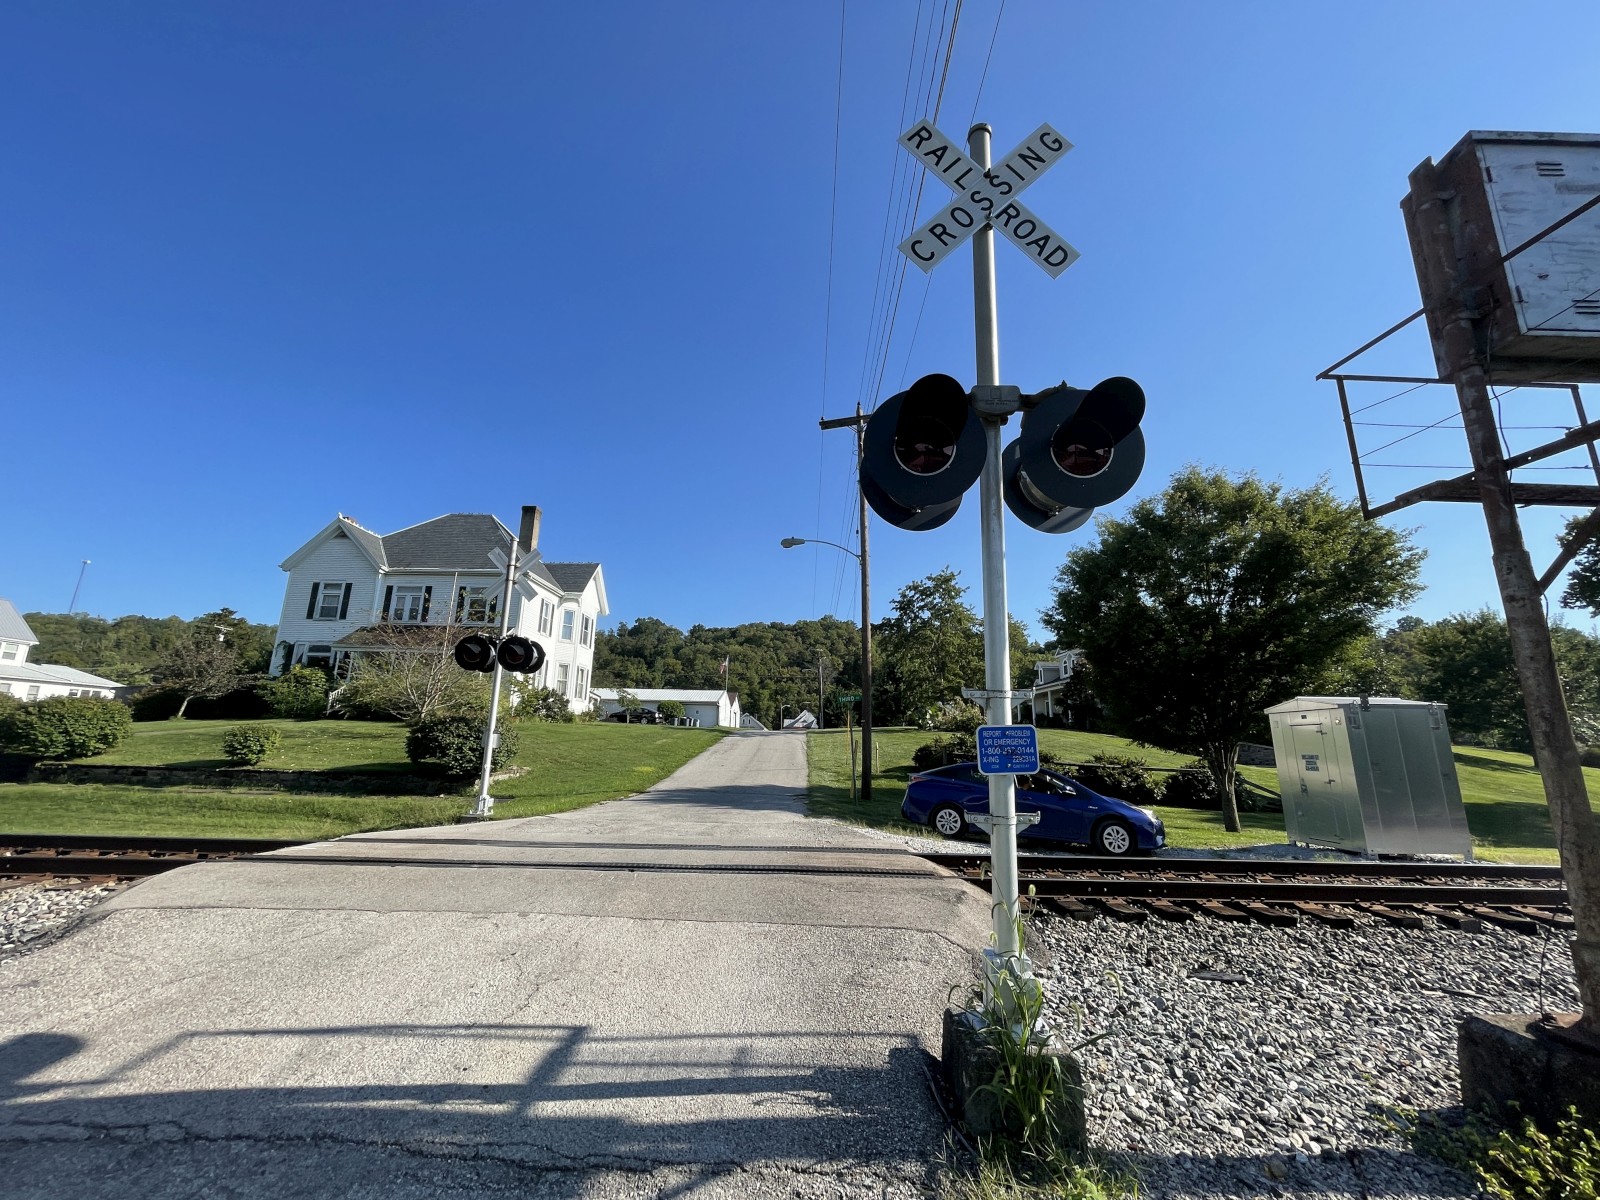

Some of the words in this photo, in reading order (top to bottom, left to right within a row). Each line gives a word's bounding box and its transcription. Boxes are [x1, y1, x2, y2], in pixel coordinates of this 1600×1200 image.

[907, 125, 973, 190] RAIL
[995, 203, 1068, 267] ROAD
[911, 132, 1063, 262] CROSSING
